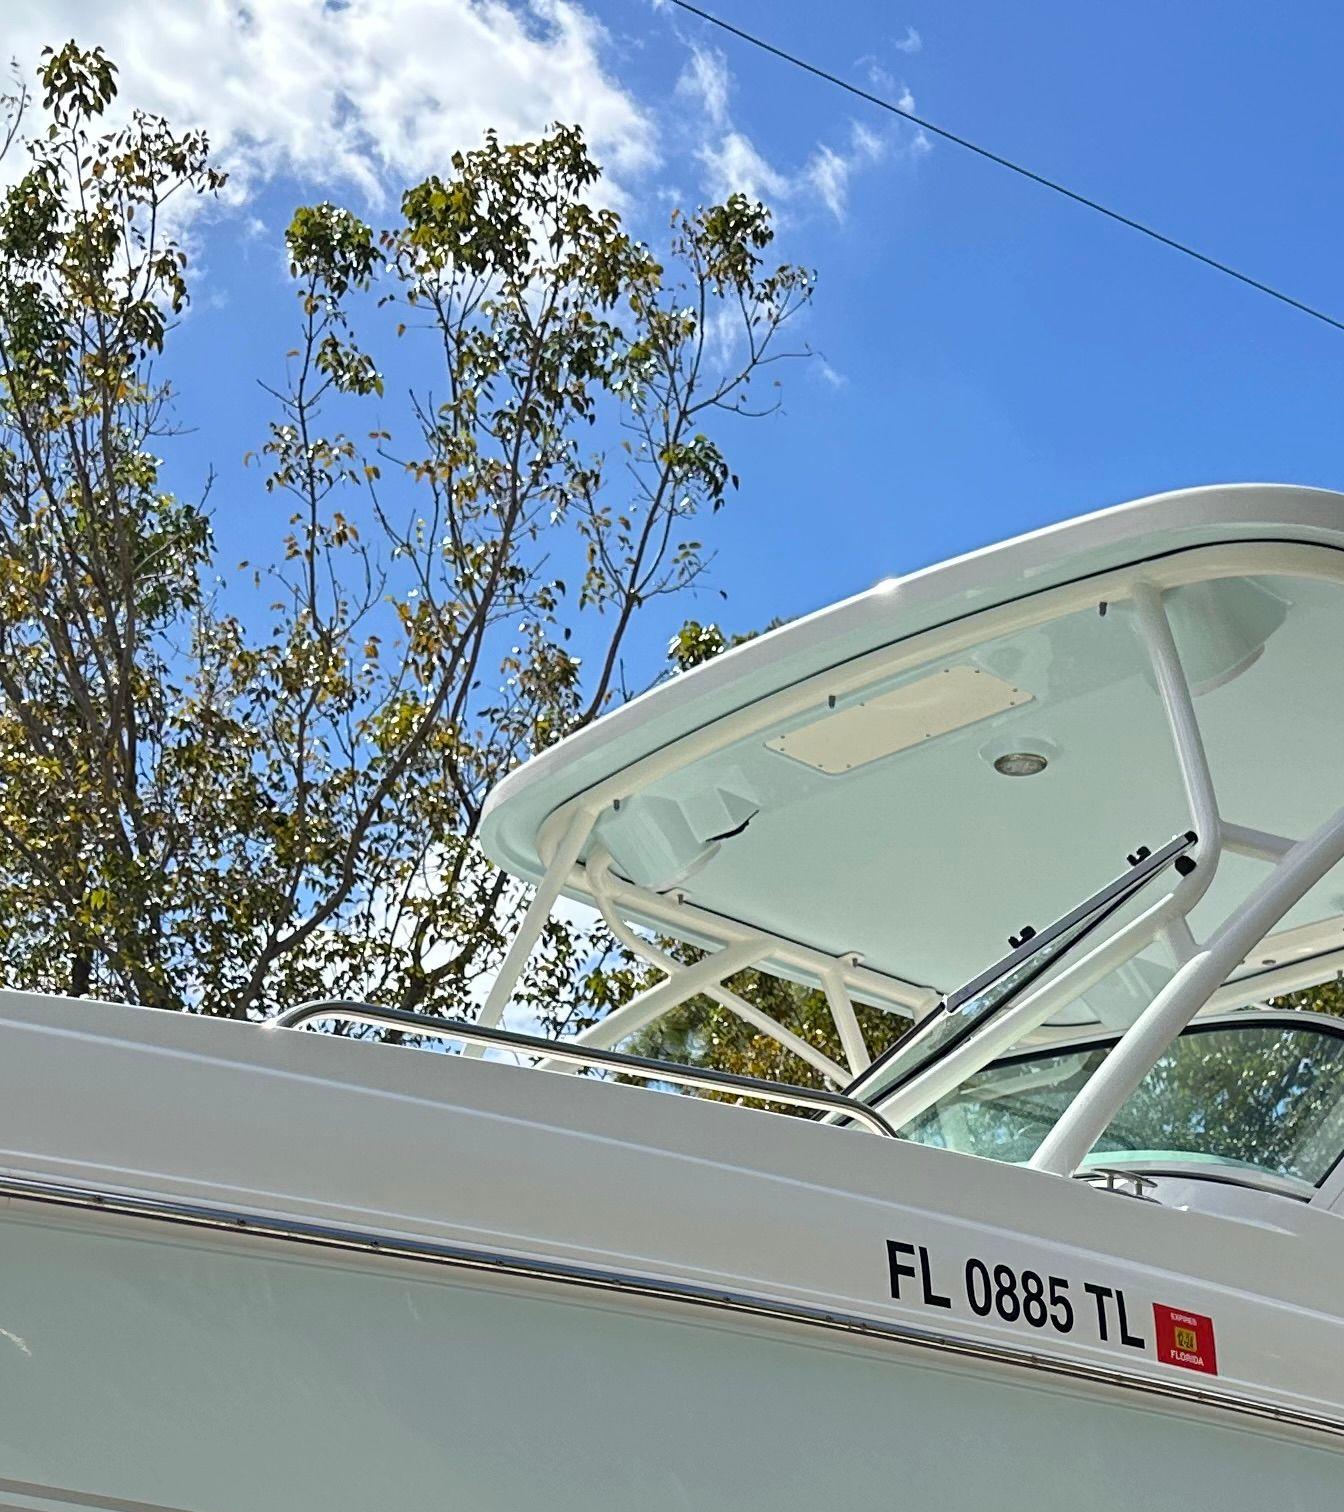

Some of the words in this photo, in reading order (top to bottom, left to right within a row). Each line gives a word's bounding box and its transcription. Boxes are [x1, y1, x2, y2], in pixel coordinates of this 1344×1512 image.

[885, 1239, 951, 1309] FL
[964, 1258, 1074, 1334] 0885
[1083, 1282, 1146, 1350] TL
[1170, 1349, 1205, 1367] FLORIDA
